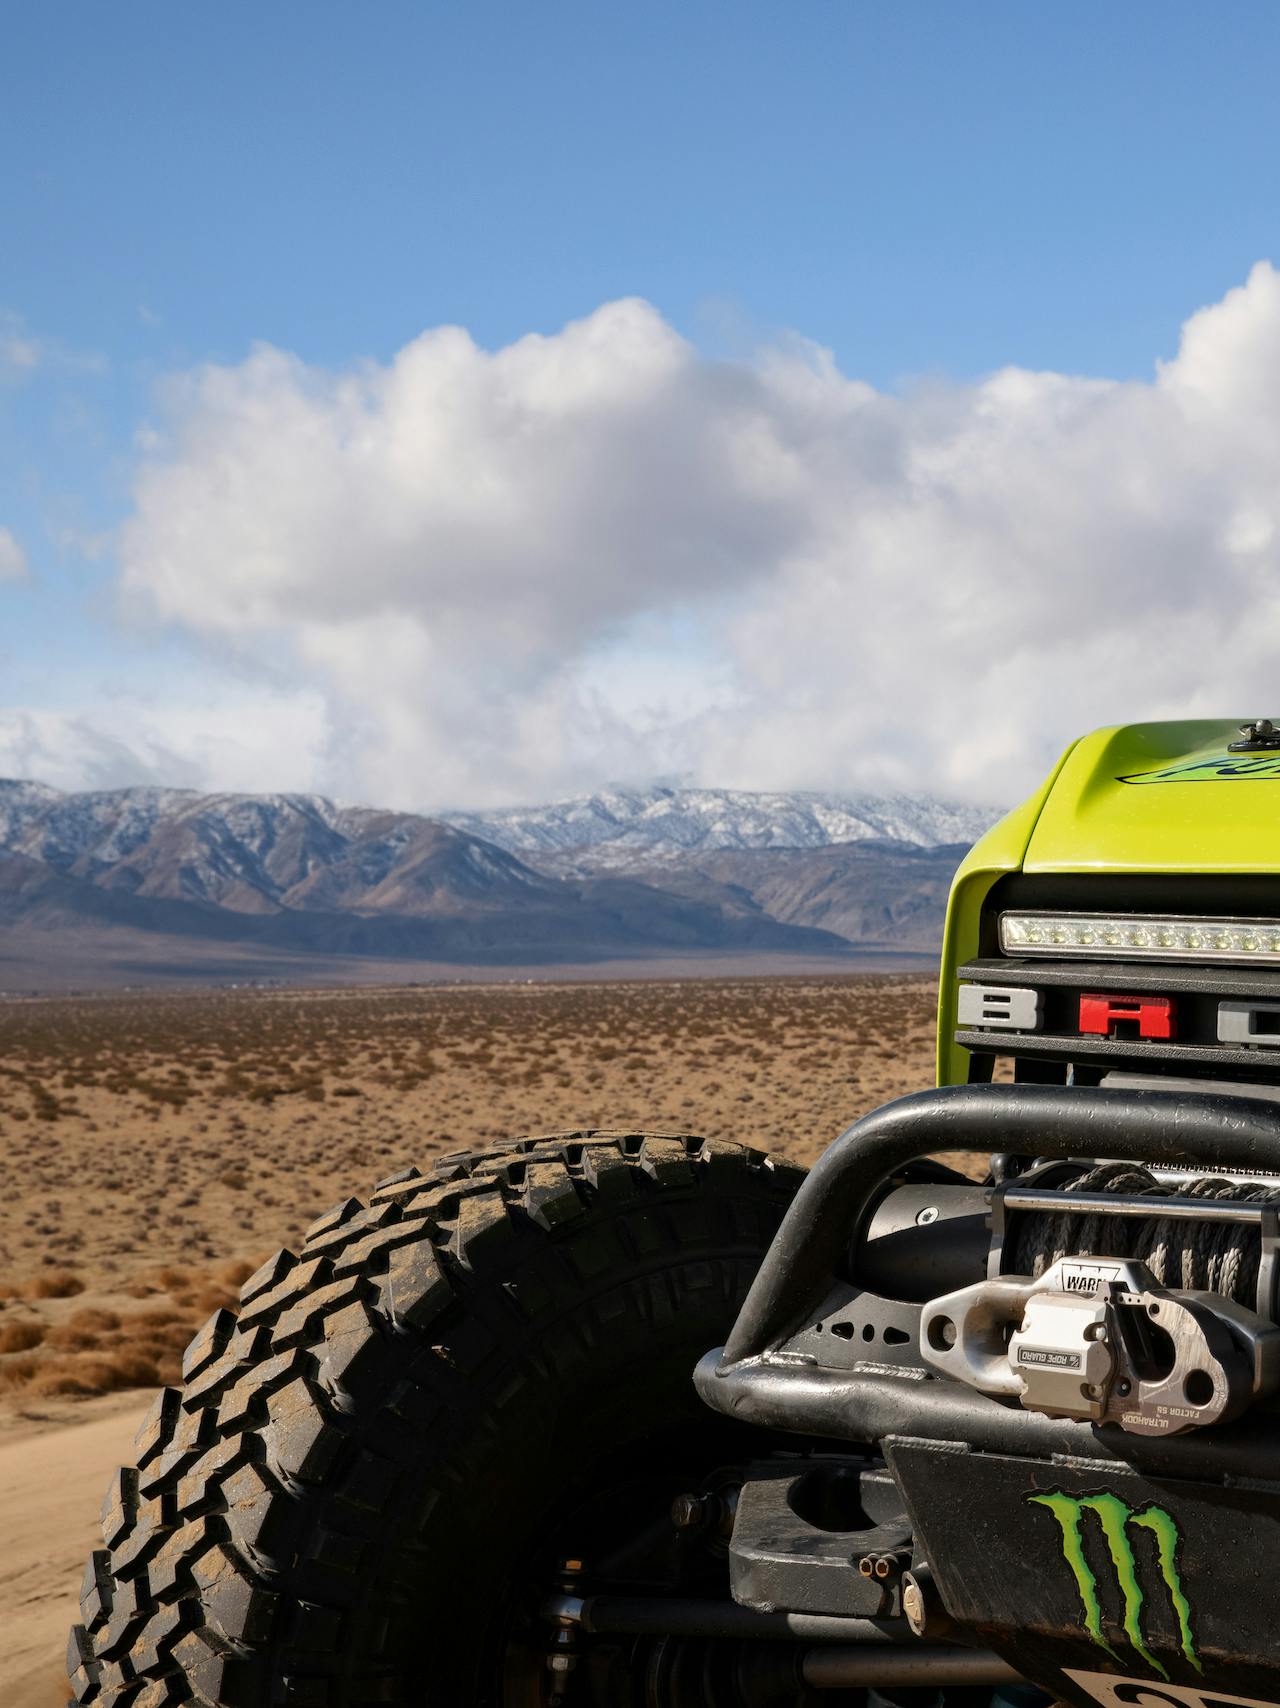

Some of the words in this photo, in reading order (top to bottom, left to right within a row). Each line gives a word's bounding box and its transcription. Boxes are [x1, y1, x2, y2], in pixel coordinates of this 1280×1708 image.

[1022, 1351, 1047, 1362] GUARD
[1048, 1353, 1067, 1364] ROPE
[1169, 1407, 1200, 1419] FACTOR
[1120, 1413, 1170, 1429] ULTRAHOOK
